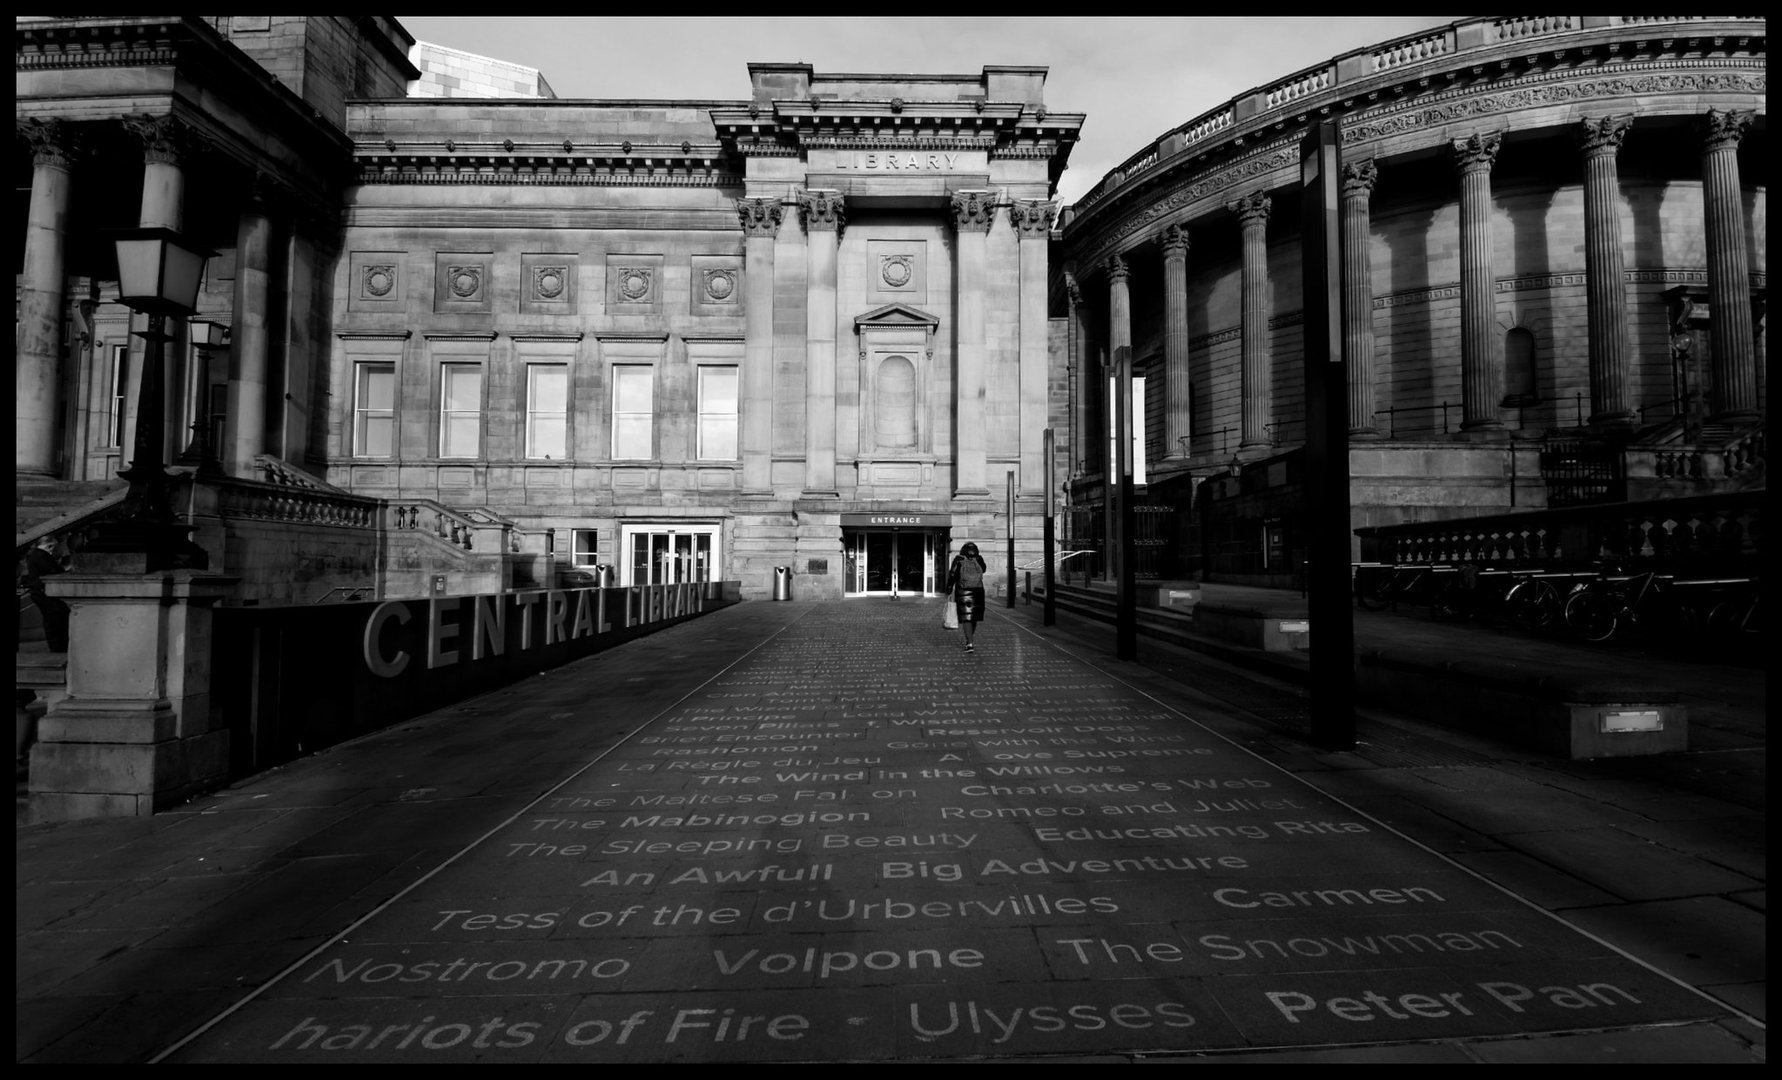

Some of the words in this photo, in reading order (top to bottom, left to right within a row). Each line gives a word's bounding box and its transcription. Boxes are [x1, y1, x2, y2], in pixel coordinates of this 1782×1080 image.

[836, 154, 959, 170] LIBRARY
[363, 588, 612, 678] CENTRAL
[626, 582, 705, 628] LIBRARY
[736, 704, 816, 713] Wizard
[932, 699, 1025, 708] Heaven
[664, 724, 749, 732] Seven
[758, 721, 840, 730] Pillars
[891, 717, 1001, 726] Wisdom
[691, 713, 797, 723] Principe
[842, 711, 905, 719] Long
[641, 735, 705, 744] Brief
[716, 732, 863, 743] Encounter
[887, 741, 968, 749] Gone
[978, 738, 1040, 747] with
[1049, 736, 1098, 744] the
[1105, 733, 1184, 744] Wind
[928, 726, 1064, 736] Reservoir
[1073, 725, 1149, 733] Dogs
[653, 745, 818, 756] Rashomon
[938, 753, 964, 762] A
[1063, 746, 1214, 760] Supreme
[617, 761, 655, 772] La
[667, 759, 761, 772] Règle
[772, 757, 812, 767] du
[824, 756, 881, 766] Jeu
[697, 774, 762, 785] The
[776, 769, 864, 782] Wind
[879, 768, 908, 780] in
[918, 767, 977, 778] the
[986, 763, 1125, 777] Willows
[961, 781, 1172, 797] Charlotte's
[1176, 776, 1271, 790] Web
[551, 797, 617, 808] The
[630, 793, 779, 806] Maltese
[940, 805, 1085, 819] Romeo
[1100, 800, 1178, 815] and
[1192, 797, 1301, 813] Juliet
[532, 818, 606, 831] The
[619, 811, 871, 828] Mabinogion
[1035, 821, 1270, 841] Educating
[1275, 817, 1371, 834] Rita
[506, 842, 588, 857] The
[601, 837, 803, 854] Sleeping
[822, 832, 978, 848] Beauty
[580, 869, 656, 887] An
[669, 863, 834, 884] Awfull
[882, 861, 963, 881] Big
[981, 854, 1249, 876] Adventure
[1212, 884, 1446, 909] Carmen
[431, 909, 559, 931] Tess
[577, 905, 645, 929] of
[651, 903, 742, 927] the
[1056, 938, 1184, 965] The
[1198, 928, 1524, 962] Snowman
[302, 958, 631, 984] Nostromo
[712, 948, 985, 978] Volpone
[1264, 990, 1478, 1023] Peter
[1478, 981, 1642, 1014] Pan
[564, 1010, 653, 1045] of
[664, 1008, 812, 1044] Fire
[909, 1001, 1197, 1043] Ulysses
